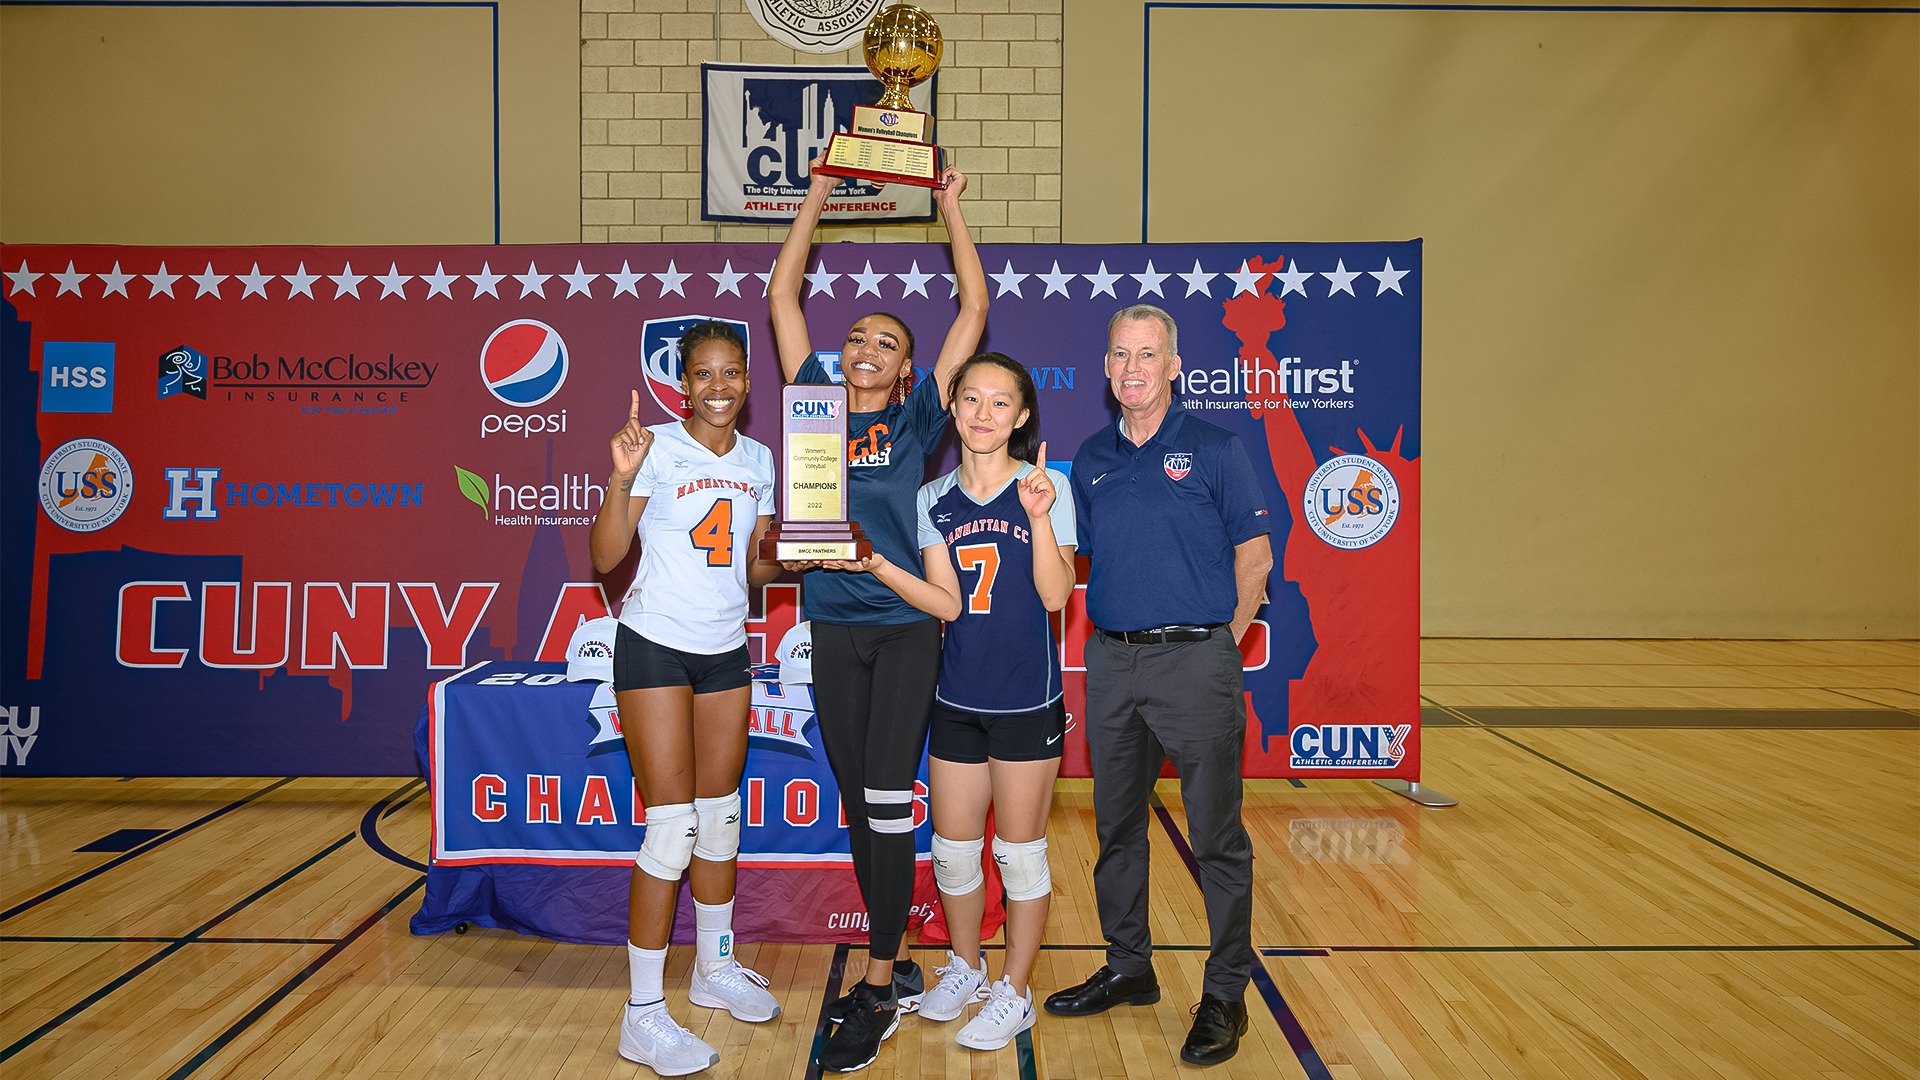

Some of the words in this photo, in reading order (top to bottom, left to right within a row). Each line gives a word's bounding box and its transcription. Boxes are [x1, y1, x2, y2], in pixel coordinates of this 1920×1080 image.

[769, 0, 806, 29] HLETIC
[817, 0, 873, 32] ASSOCIATI
[857, 126, 875, 135] Women's
[876, 128, 896, 138] Volleyball
[896, 130, 918, 139] Champions
[746, 186, 761, 194] The
[763, 186, 778, 196] City
[780, 187, 808, 195] Univers
[822, 201, 897, 212] ONFERENCE
[50, 366, 107, 388] HSS
[213, 353, 270, 380] Bob
[278, 353, 439, 388] McCloskey
[227, 391, 409, 402] INSURANCE
[680, 400, 694, 409] 19
[1182, 399, 1203, 410] alth
[1205, 399, 1262, 410] Insurance
[1264, 399, 1280, 410] for
[1284, 399, 1310, 410] New
[1312, 399, 1355, 409] Yorkers
[792, 401, 842, 416] CUNY
[481, 409, 567, 438] pepsi
[44, 443, 77, 475] UNIVERSITY
[77, 441, 113, 453] STUDENT
[111, 451, 129, 475] SENATE
[804, 463, 827, 471] Volleyball
[820, 455, 838, 463] College
[55, 471, 117, 499] USS
[793, 482, 838, 490] CHAMPIONS
[1308, 460, 1341, 493] UNIVERSITY
[1341, 457, 1376, 469] STUDENT
[1376, 466, 1394, 491] SENATE
[226, 483, 423, 506] HOMETOWN
[495, 474, 608, 511] health
[677, 478, 748, 499] MANHATTAN
[42, 493, 53, 510] CITY
[50, 509, 90, 530] UNIVERSITY
[91, 521, 101, 529] OF
[101, 512, 117, 525] NEW
[116, 493, 129, 513] YORK
[1320, 487, 1384, 515] USS
[495, 515, 532, 526] Health
[534, 515, 590, 526] Insurance
[1308, 511, 1319, 528] CITY
[1317, 526, 1358, 547] UNIVERSITY
[1359, 537, 1369, 545] OF
[1369, 528, 1386, 542] NEW
[1385, 509, 1396, 529] YORK
[689, 498, 733, 568] 4
[946, 519, 1009, 546] ANHATTAN
[1013, 525, 1029, 544] CC
[956, 543, 1001, 614] 7
[116, 581, 500, 670] CUNY
[583, 647, 604, 658] NYC
[797, 648, 812, 659] NY
[1292, 725, 1411, 760] CUNY
